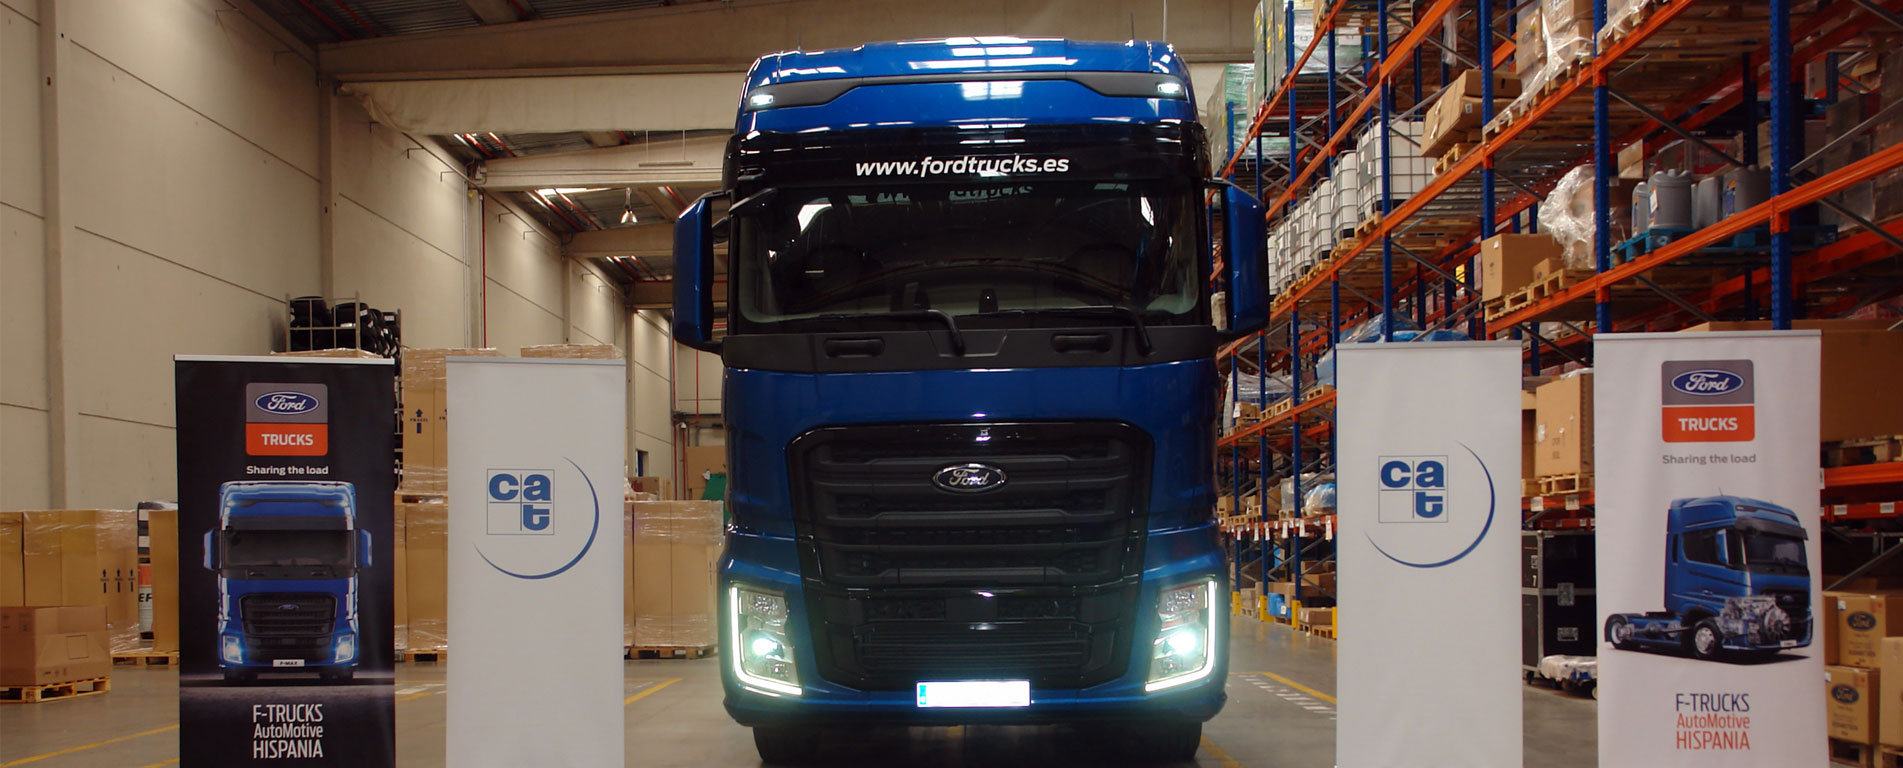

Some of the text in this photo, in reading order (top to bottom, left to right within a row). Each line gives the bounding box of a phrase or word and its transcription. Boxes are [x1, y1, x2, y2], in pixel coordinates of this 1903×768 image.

[855, 156, 1070, 178] www.fordtrucks.es
[1685, 373, 1730, 391] Ford
[267, 394, 307, 410] Ford
[1678, 417, 1738, 431] TRUCKS
[261, 433, 314, 446] TRUCKS
[1662, 453, 1756, 465] Sharing the load
[246, 465, 329, 476] Sharing the load
[949, 468, 990, 486] Ford
[1676, 693, 1750, 712] F-TRUCKS
[253, 704, 324, 723] F-TRUCKS
[1676, 713, 1750, 729] AutoMotive
[253, 723, 324, 738] AutoMotive
[1676, 730, 1751, 750] HISPANIA
[253, 739, 324, 759] HISPANIA
